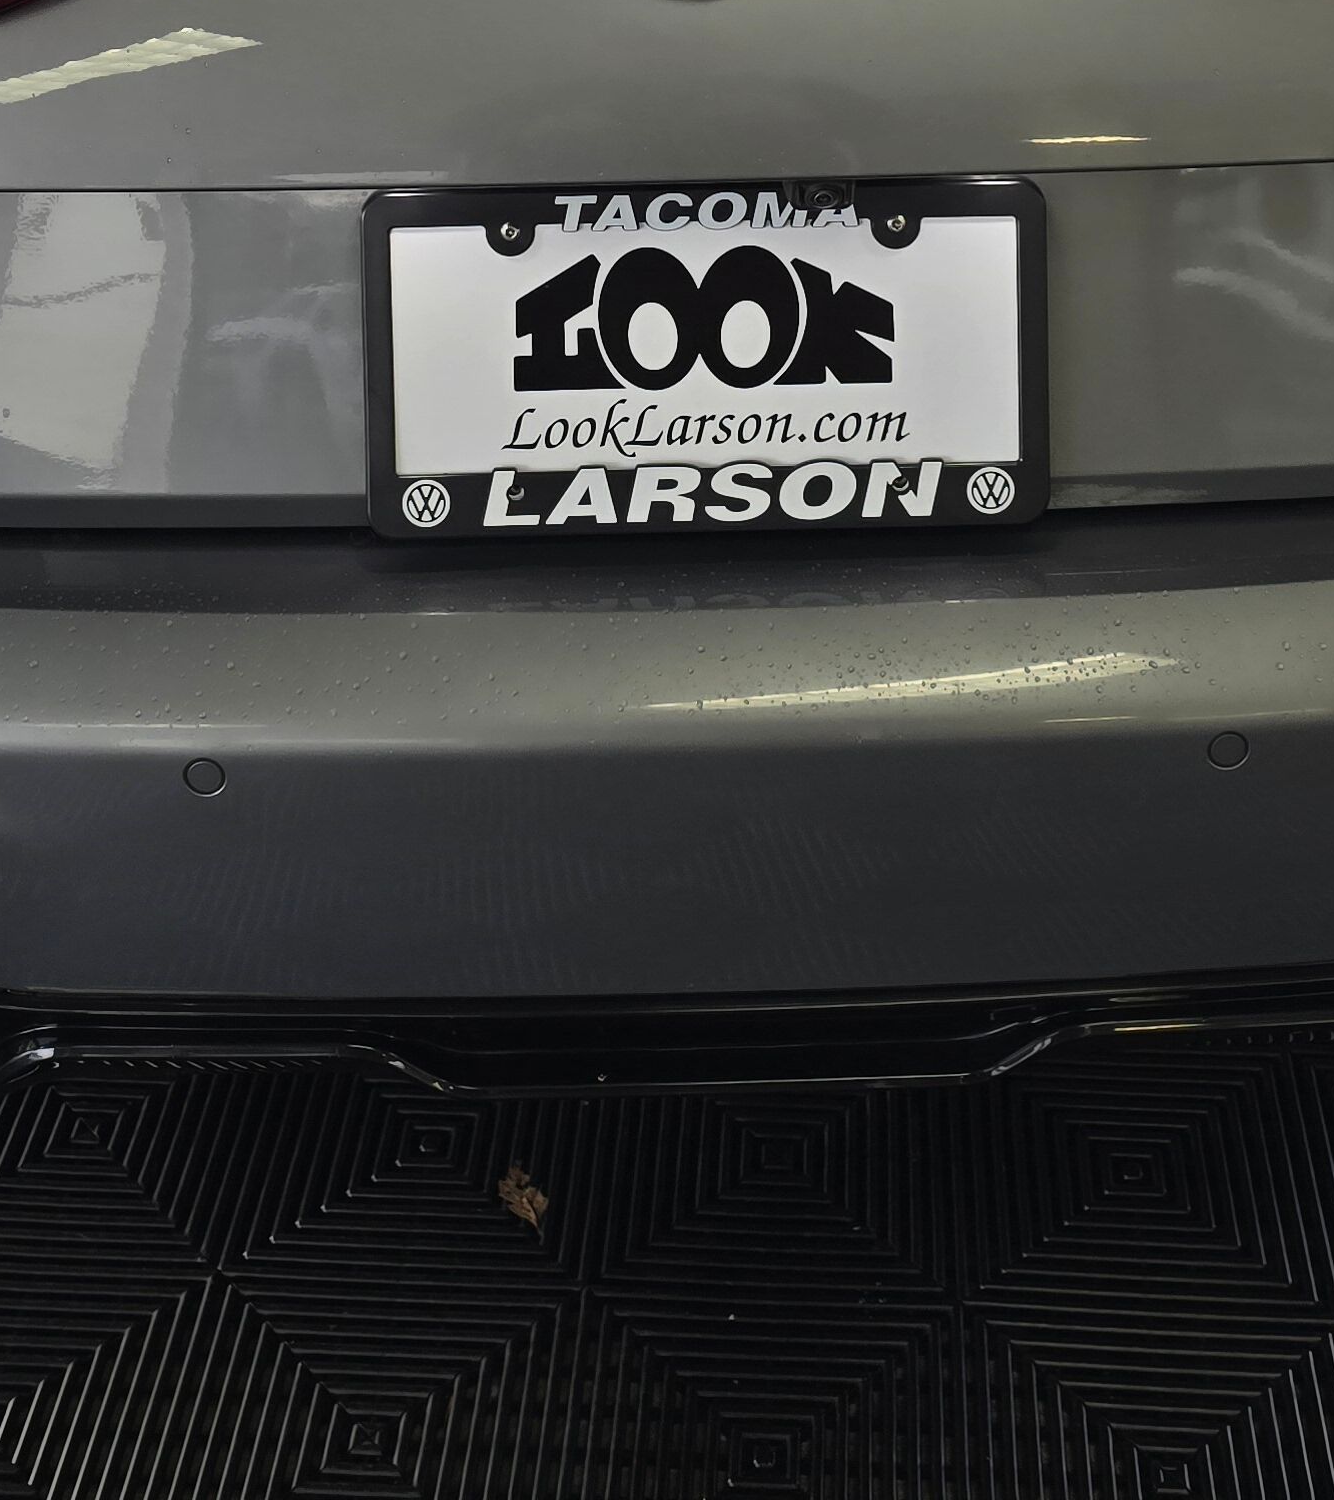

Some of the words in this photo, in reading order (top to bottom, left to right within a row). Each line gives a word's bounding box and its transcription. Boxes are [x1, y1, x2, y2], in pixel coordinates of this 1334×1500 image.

[514, 245, 894, 391] LOOK
[501, 399, 909, 457] LookLarson.com
[483, 461, 943, 527] LARSON
